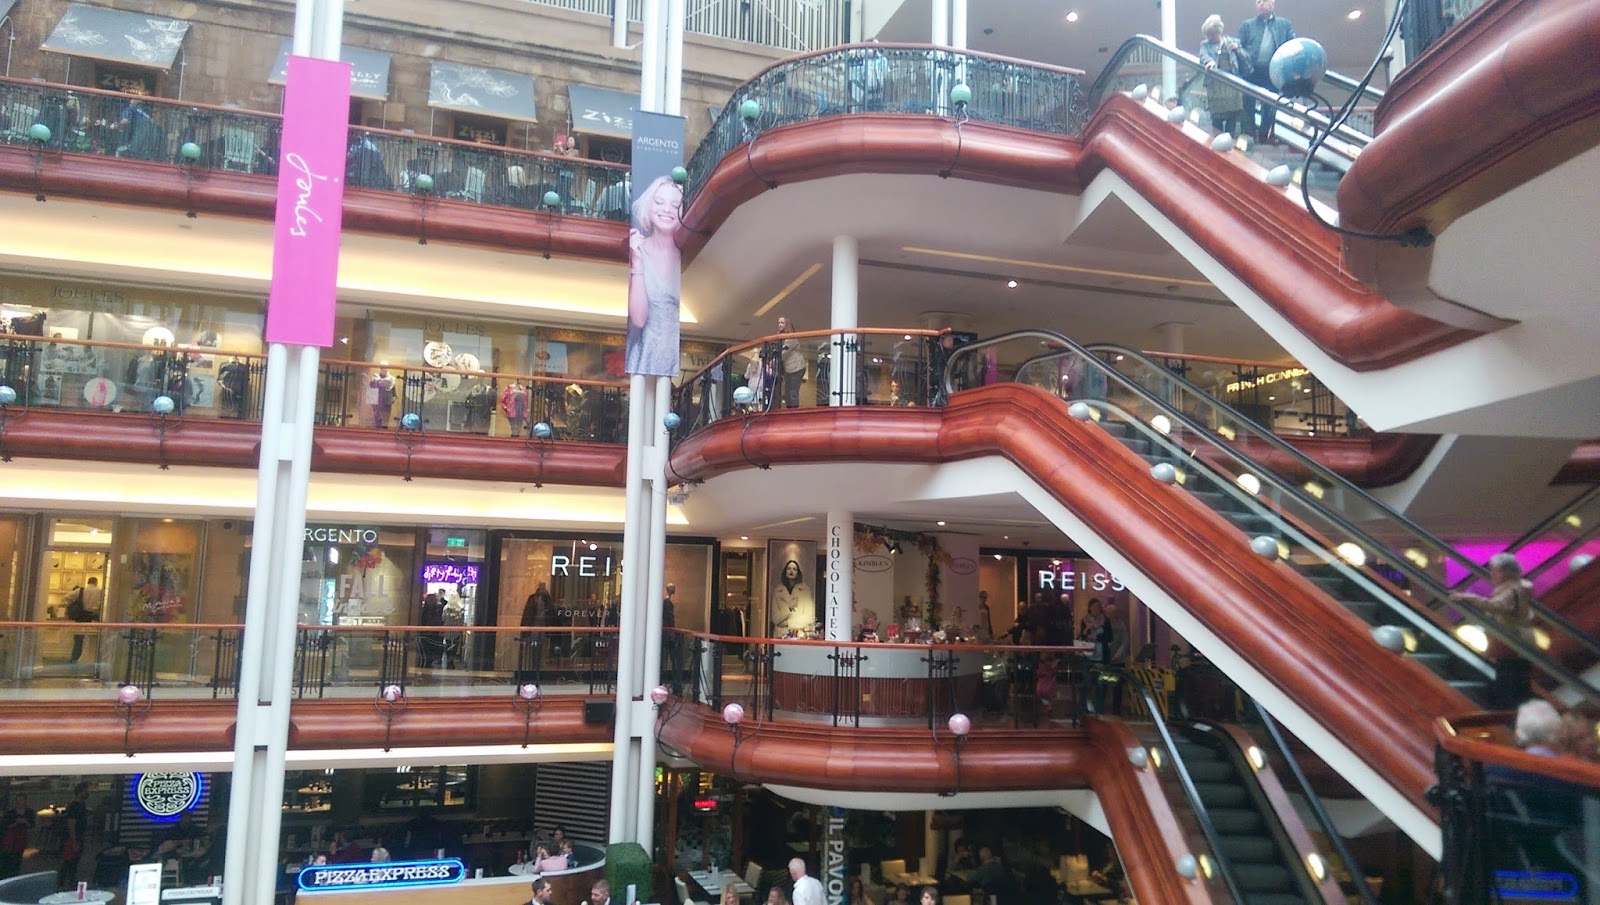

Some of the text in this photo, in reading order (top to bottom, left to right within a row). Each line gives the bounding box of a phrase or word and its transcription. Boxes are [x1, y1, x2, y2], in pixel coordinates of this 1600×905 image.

[637, 136, 679, 149] ARGENTO
[50, 286, 124, 304] JOULES
[302, 527, 377, 543] RGENTO
[551, 555, 624, 577] REI
[340, 574, 389, 599] FALL
[830, 525, 841, 641] CHOCOLATES
[1038, 569, 1126, 592] REISS
[557, 609, 610, 618] FOREVER
[144, 786, 190, 795] EXPRESS
[153, 780, 183, 788] PIZZA
[828, 818, 844, 836] IL
